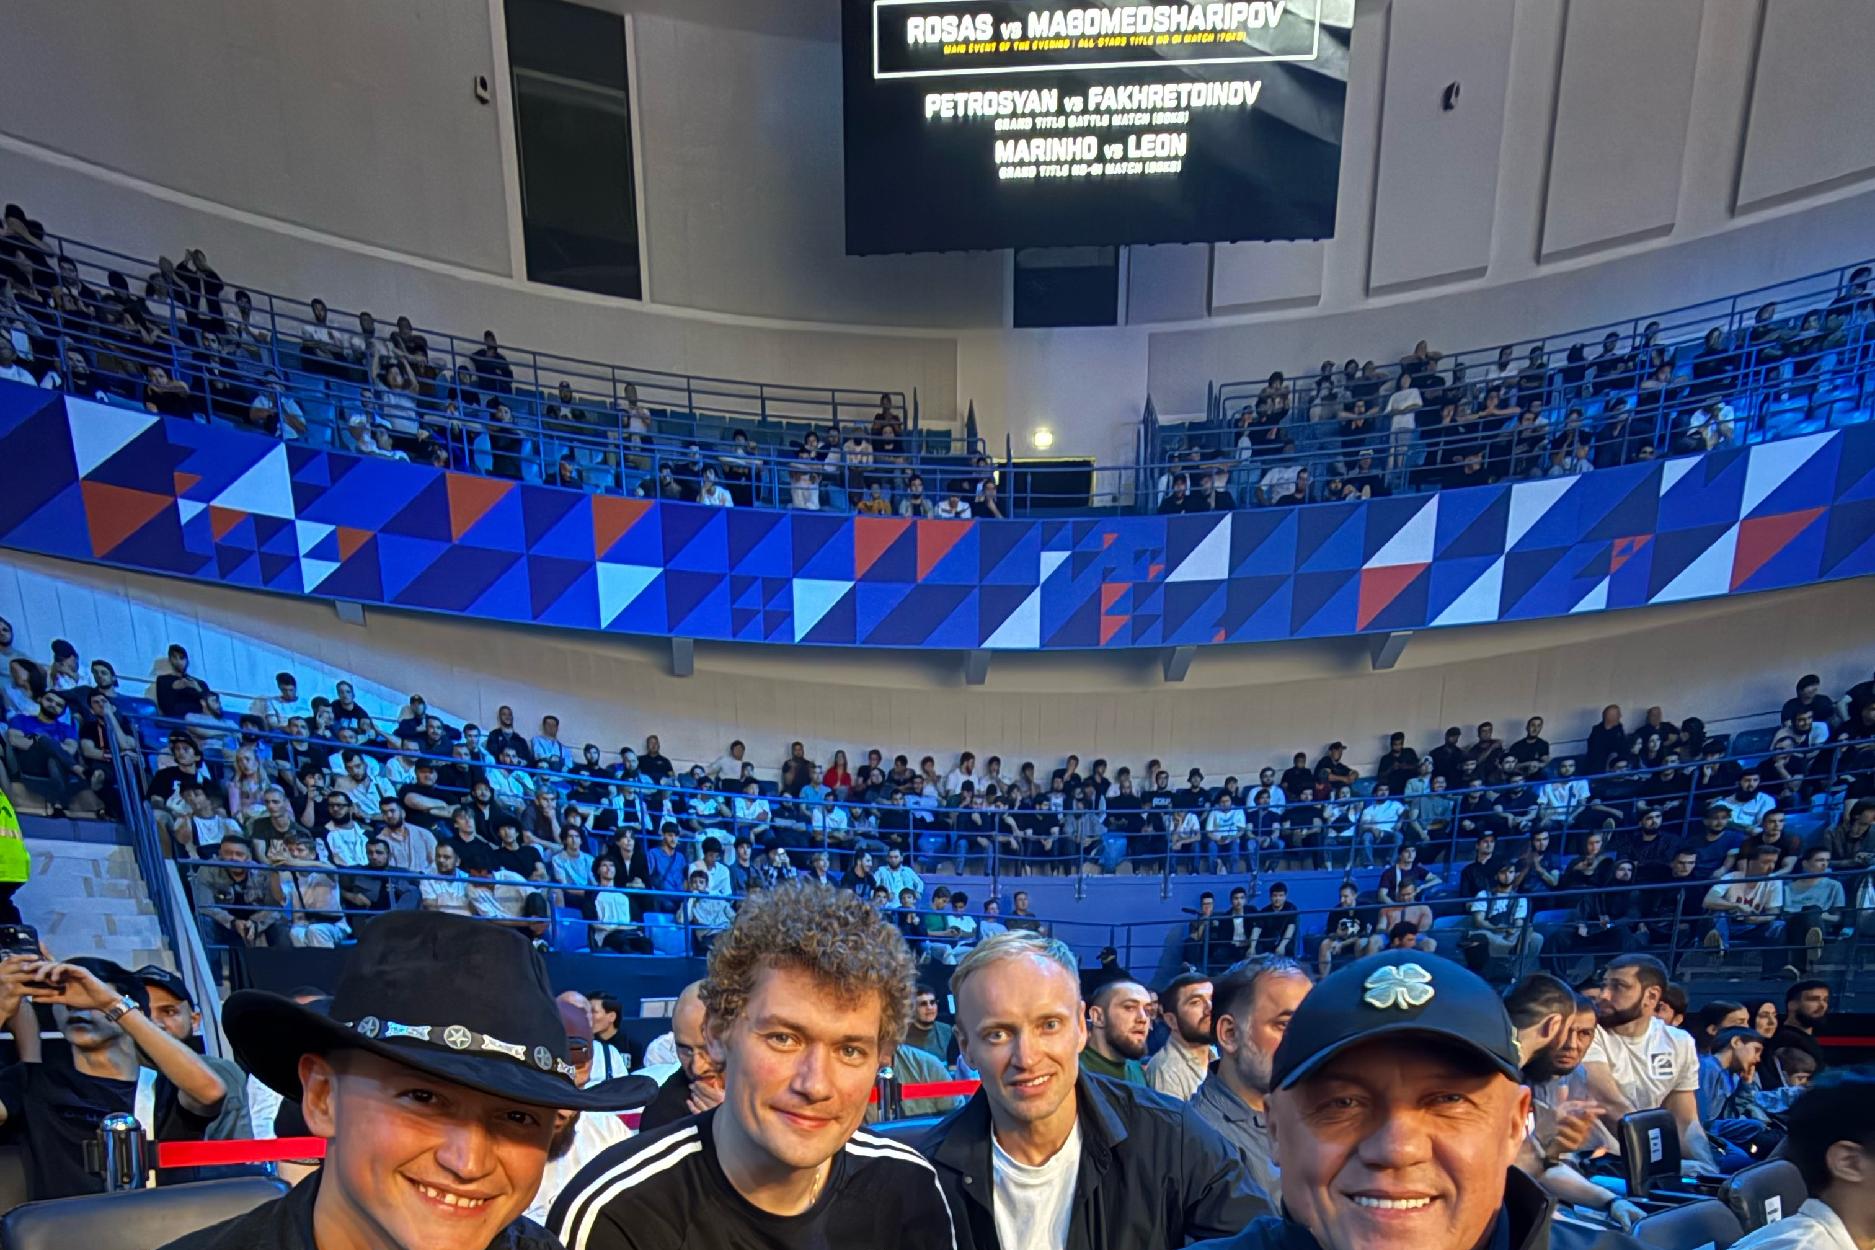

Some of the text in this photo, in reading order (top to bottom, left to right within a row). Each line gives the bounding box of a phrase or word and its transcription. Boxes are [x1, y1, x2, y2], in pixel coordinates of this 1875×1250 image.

[907, 13, 994, 44] ROSAS
[1027, 1, 1285, 39] MAGOMEDSHARIPOV
[943, 44, 966, 55] MAIN
[968, 42, 997, 54] EVENT
[999, 41, 1011, 52] OF
[1013, 40, 1031, 51] THE
[1032, 38, 1071, 51] EVENING
[924, 88, 1058, 119] PETROSYAN
[1087, 81, 1262, 111] FAKHRETDINOV
[994, 117, 1033, 131] GRAND
[1035, 115, 1066, 129] TITLE
[1111, 112, 1151, 126] MATCH
[994, 135, 1098, 164] MARINHO
[1127, 132, 1188, 159] LEON
[998, 166, 1037, 180] GRAND
[1039, 164, 1070, 178] TITLE
[1104, 162, 1143, 175] MATCH
